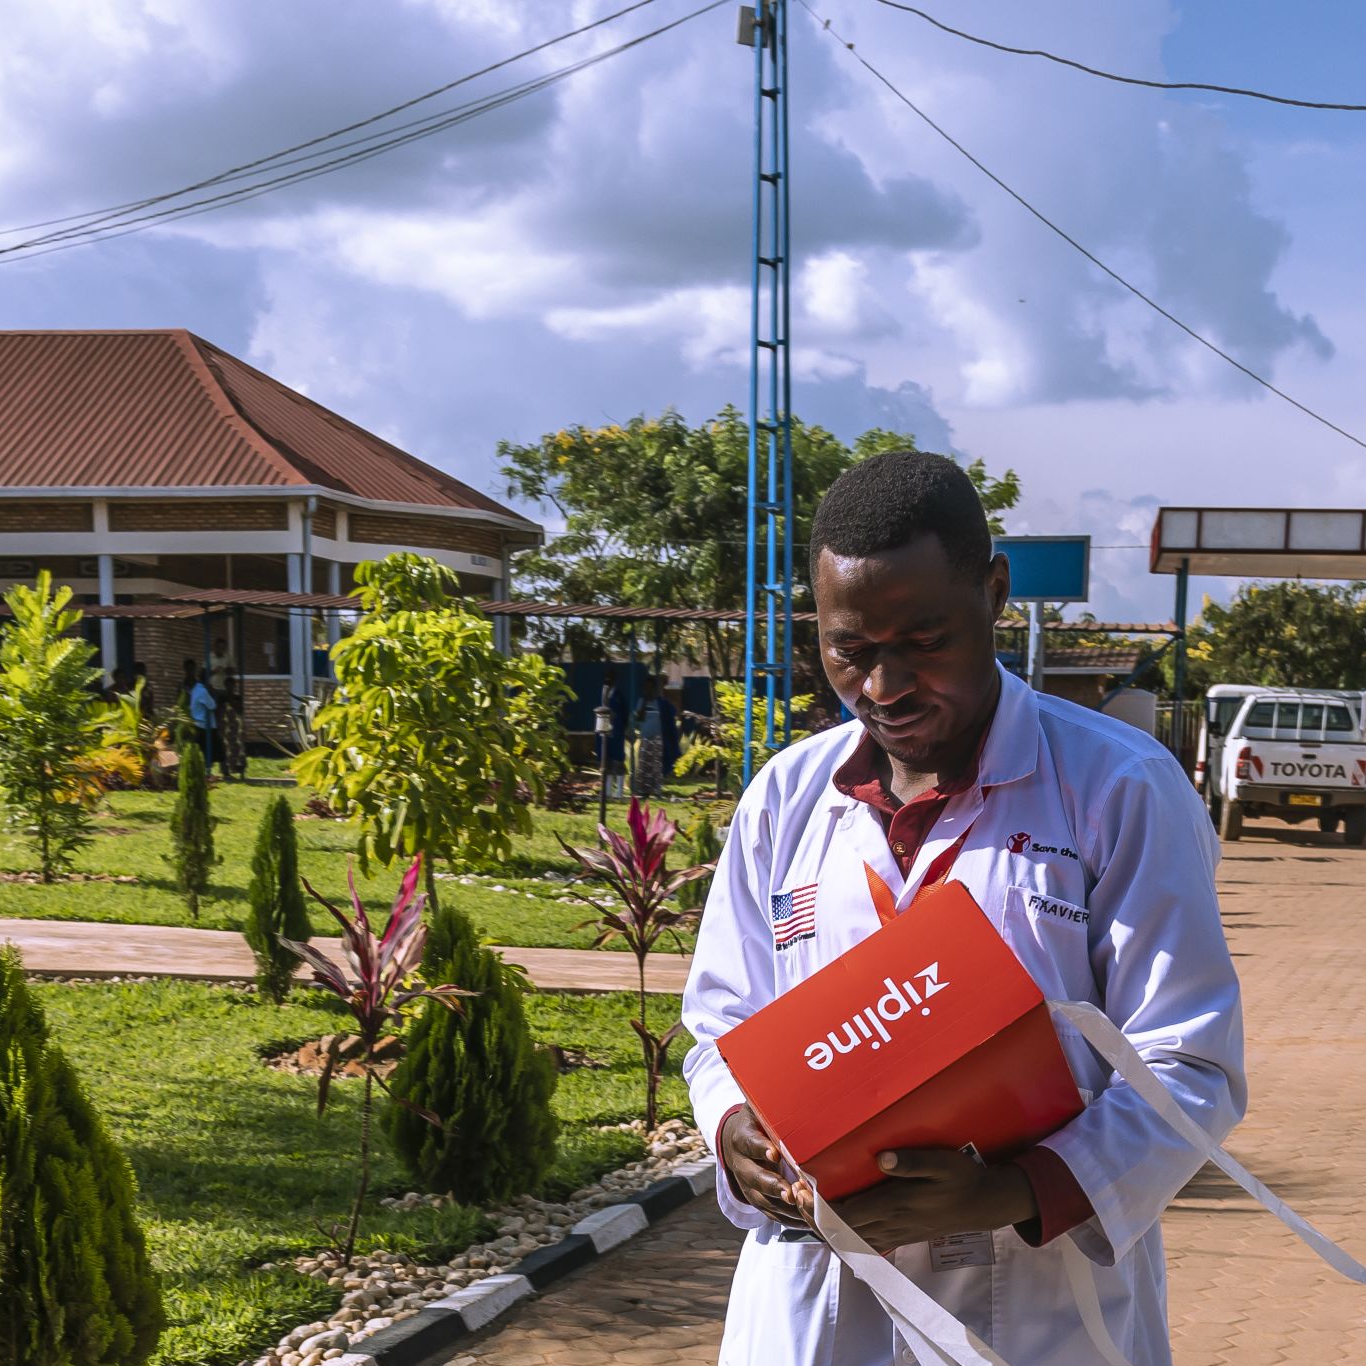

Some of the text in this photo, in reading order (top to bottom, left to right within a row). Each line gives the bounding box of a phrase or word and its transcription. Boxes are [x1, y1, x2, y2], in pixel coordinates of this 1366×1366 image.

[1270, 762, 1347, 779] TOYOTA
[1031, 843, 1079, 860] Save the
[803, 961, 951, 1071] zipline
